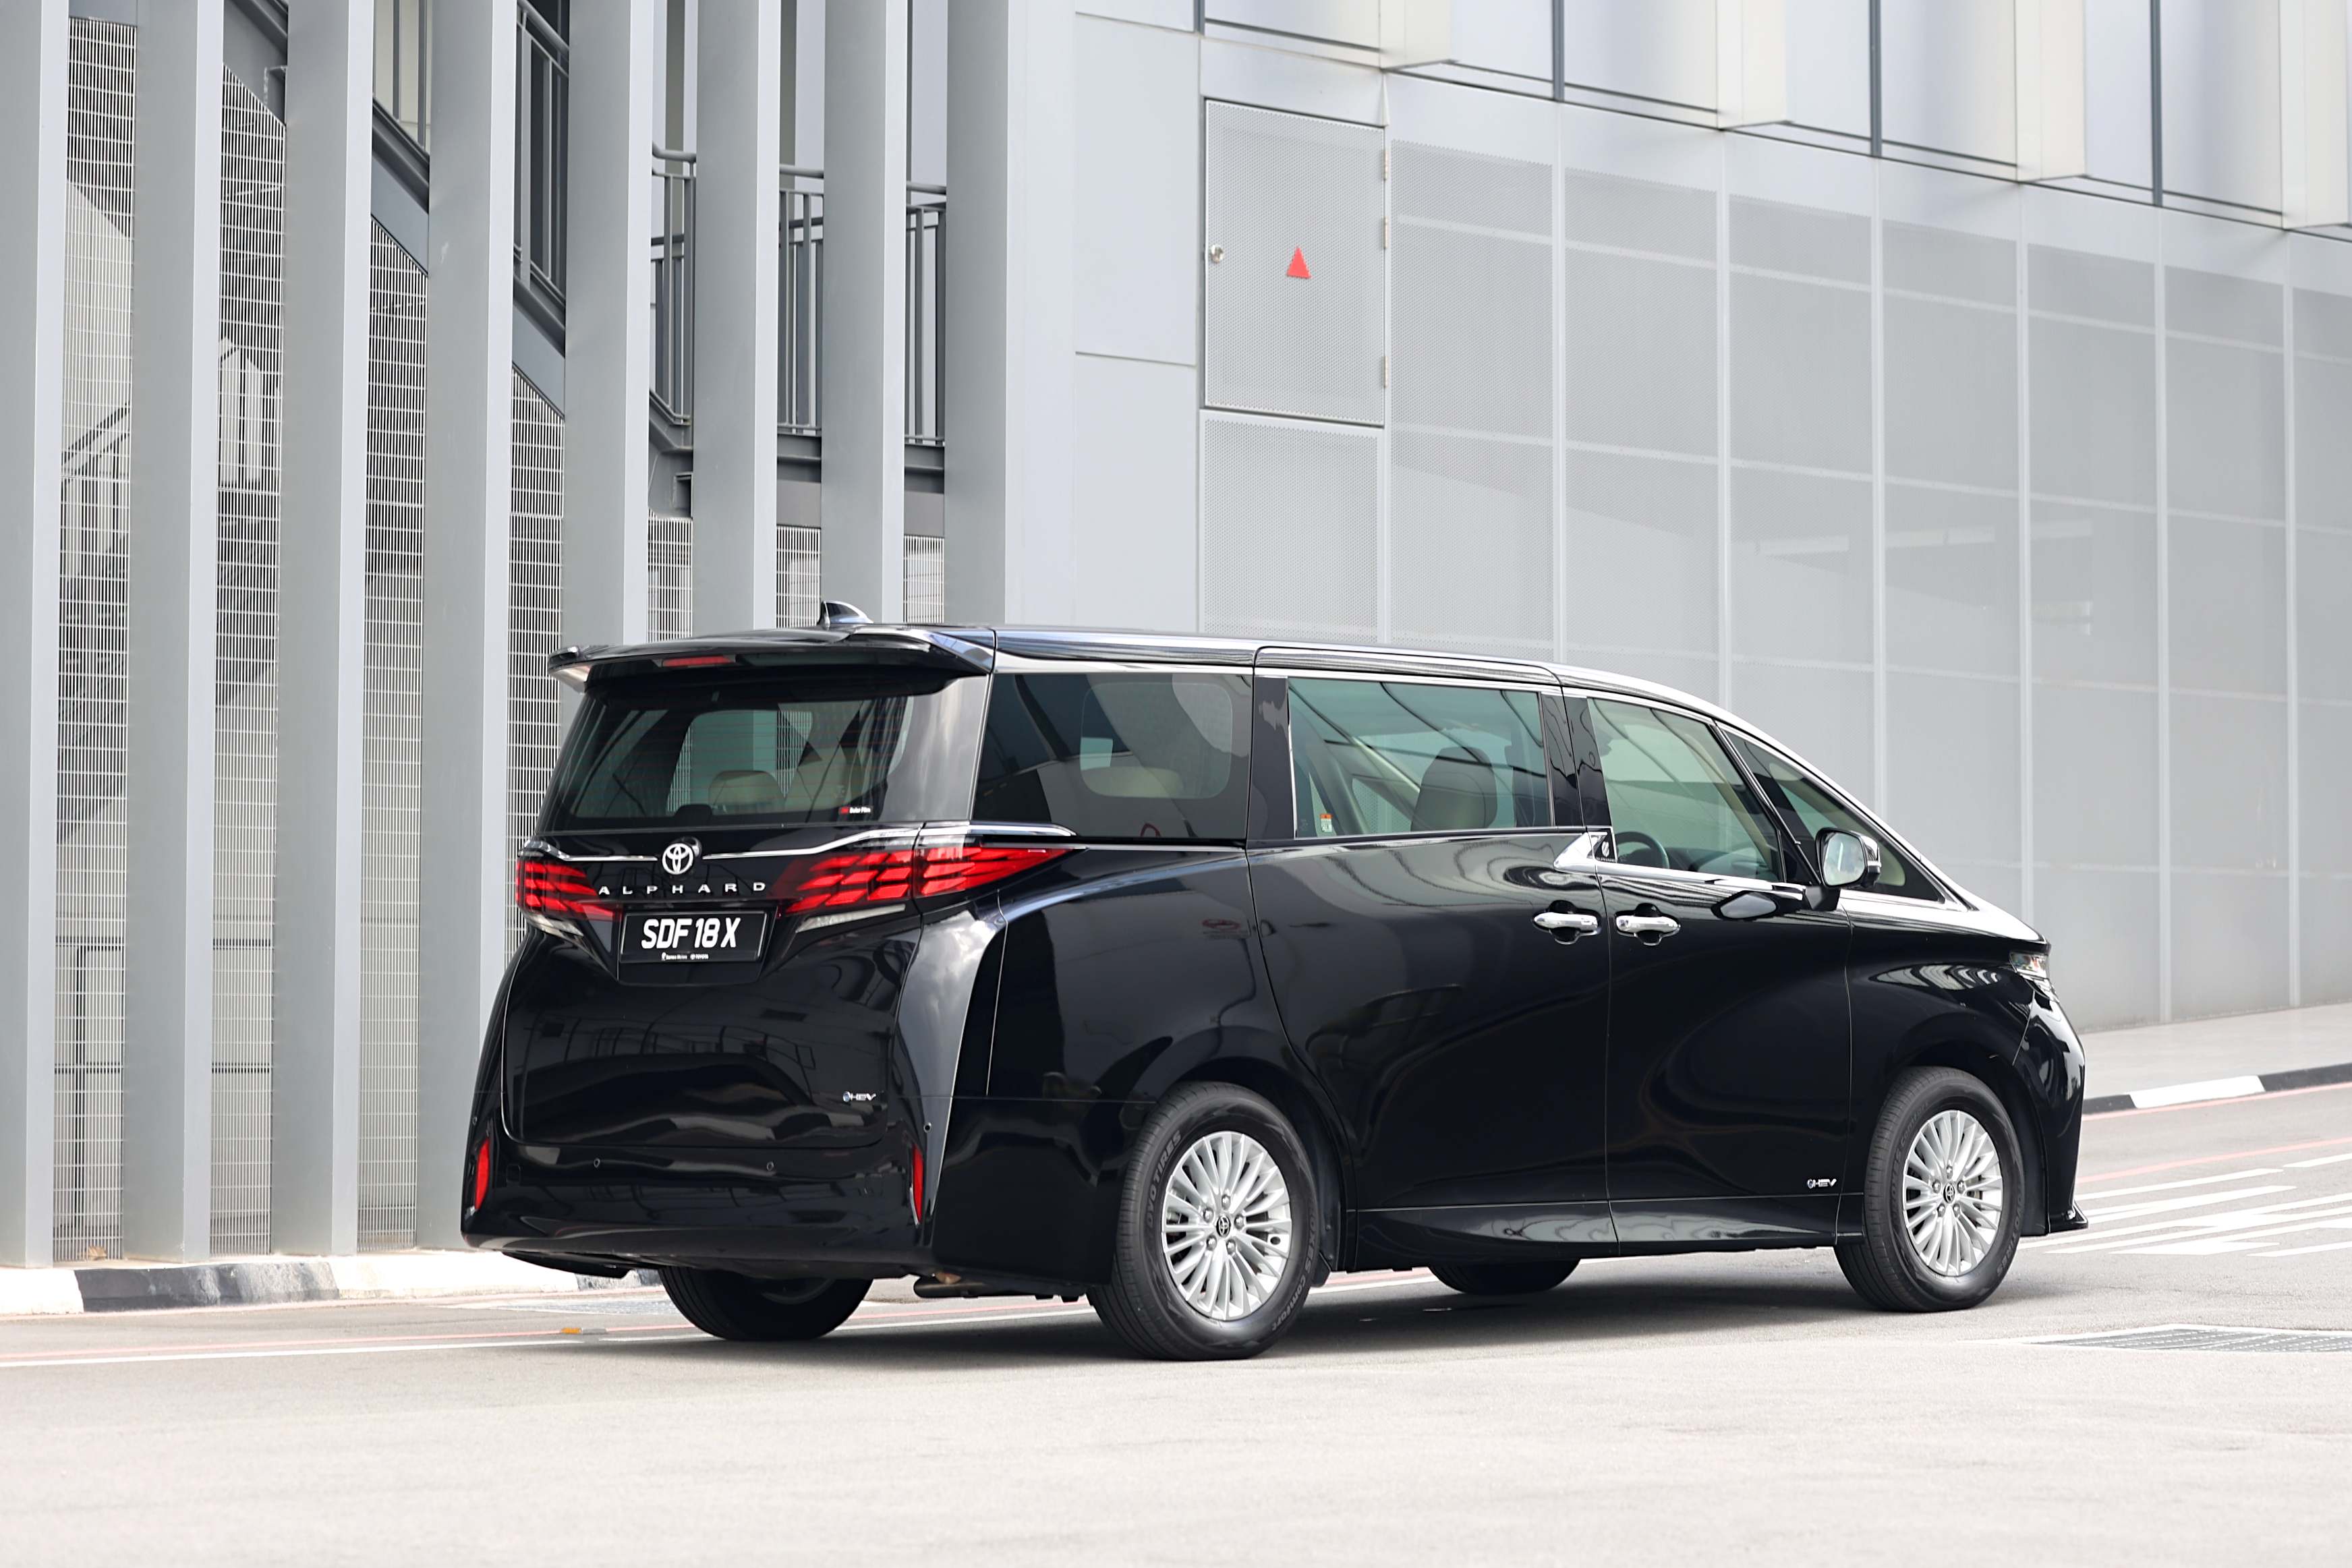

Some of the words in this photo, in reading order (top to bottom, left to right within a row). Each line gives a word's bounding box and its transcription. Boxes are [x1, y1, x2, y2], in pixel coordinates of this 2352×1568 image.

[599, 882, 766, 895] ALPHARD
[641, 919, 692, 949] SDF
[694, 918, 720, 948] 18
[720, 917, 741, 948] X
[851, 1093, 876, 1101] HEV
[1153, 1130, 1181, 1183] TIRES
[1812, 1178, 1837, 1187] HEV
